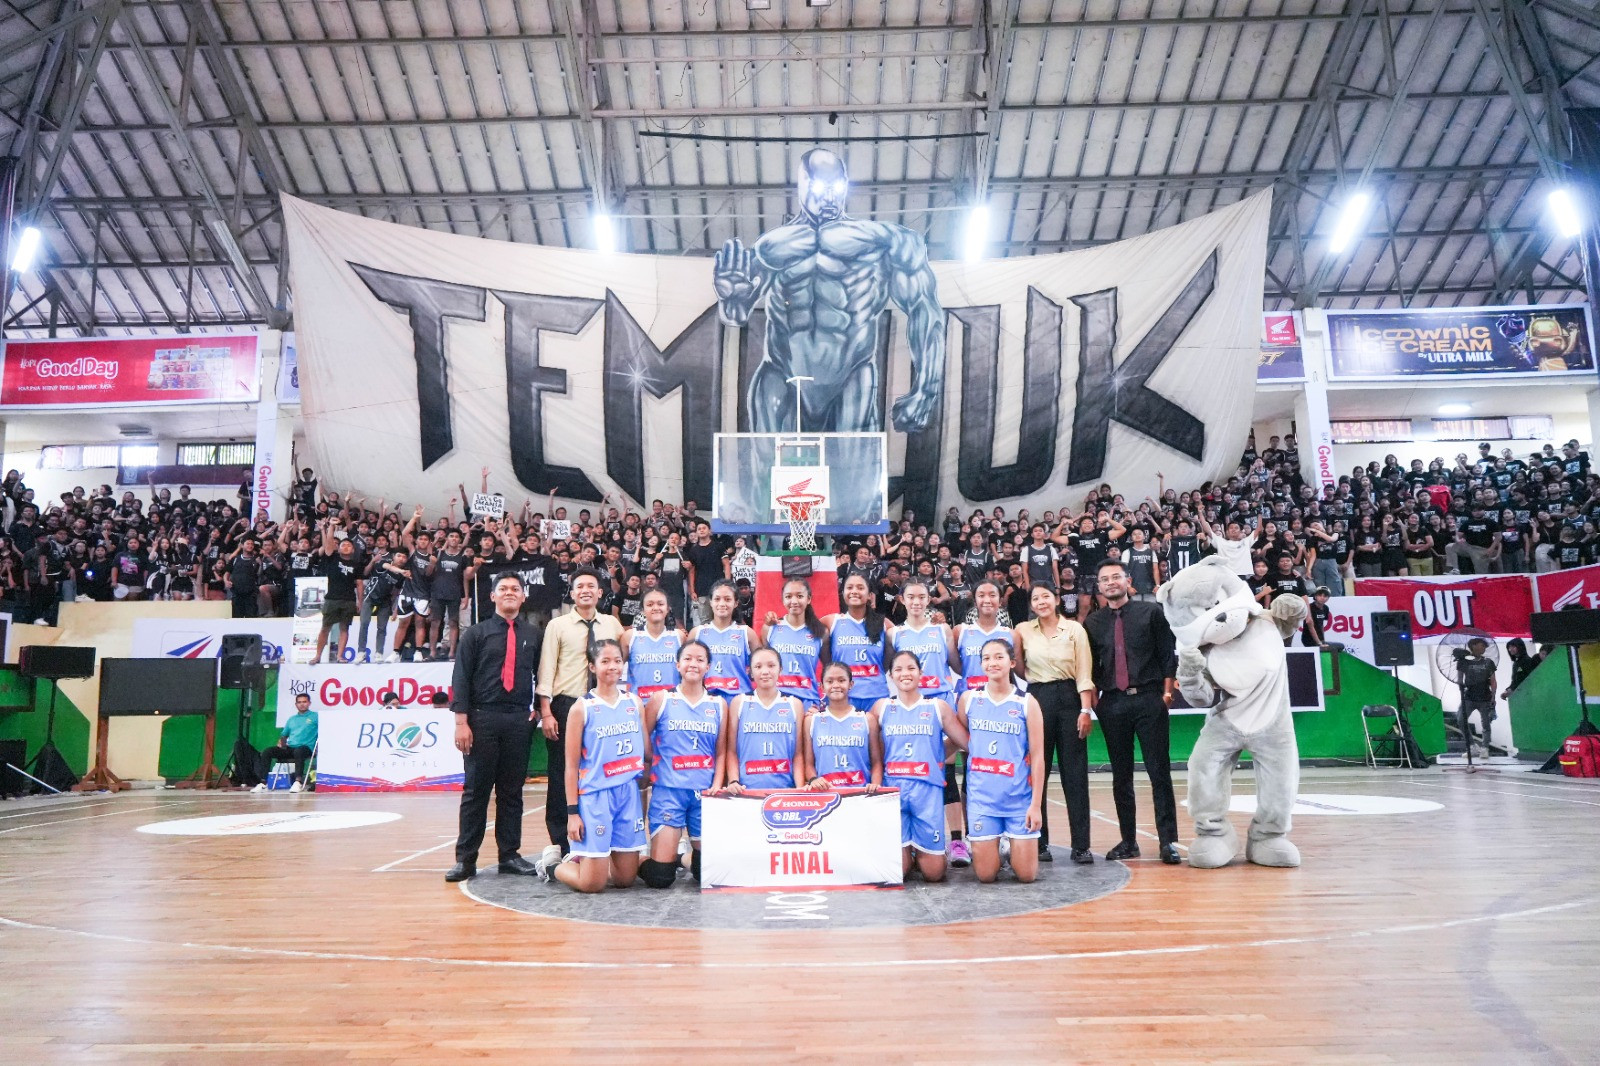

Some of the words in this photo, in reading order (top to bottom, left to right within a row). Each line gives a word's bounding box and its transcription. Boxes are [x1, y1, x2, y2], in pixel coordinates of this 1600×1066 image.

[1400, 338, 1492, 353] CREAM
[1428, 352, 1463, 363] ULTRA
[1466, 351, 1494, 362] MILK
[346, 248, 1217, 517] TEMUK
[1178, 551, 1190, 570] 11
[1413, 589, 1473, 627] OUT
[709, 644, 741, 656] ANSATU
[855, 649, 867, 662] 16
[714, 661, 723, 674] 4
[788, 661, 800, 674] 12
[653, 669, 662, 683] 8
[668, 719, 717, 734] SMANSATU
[743, 722, 792, 734] SMANSATU
[885, 724, 934, 736] SMANSATU
[971, 718, 1021, 735] SMANSATU
[357, 721, 439, 749] BROS
[817, 735, 865, 747] SMANSATU
[616, 739, 633, 756] 25
[691, 736, 699, 749] 7
[763, 741, 774, 756] 11
[905, 742, 913, 757] 5
[988, 740, 998, 755] 6
[356, 761, 437, 769] HOSPITAL
[834, 753, 849, 768] 14
[782, 811, 801, 821] DBL
[933, 830, 940, 842] 5
[770, 851, 834, 875] FINAL
